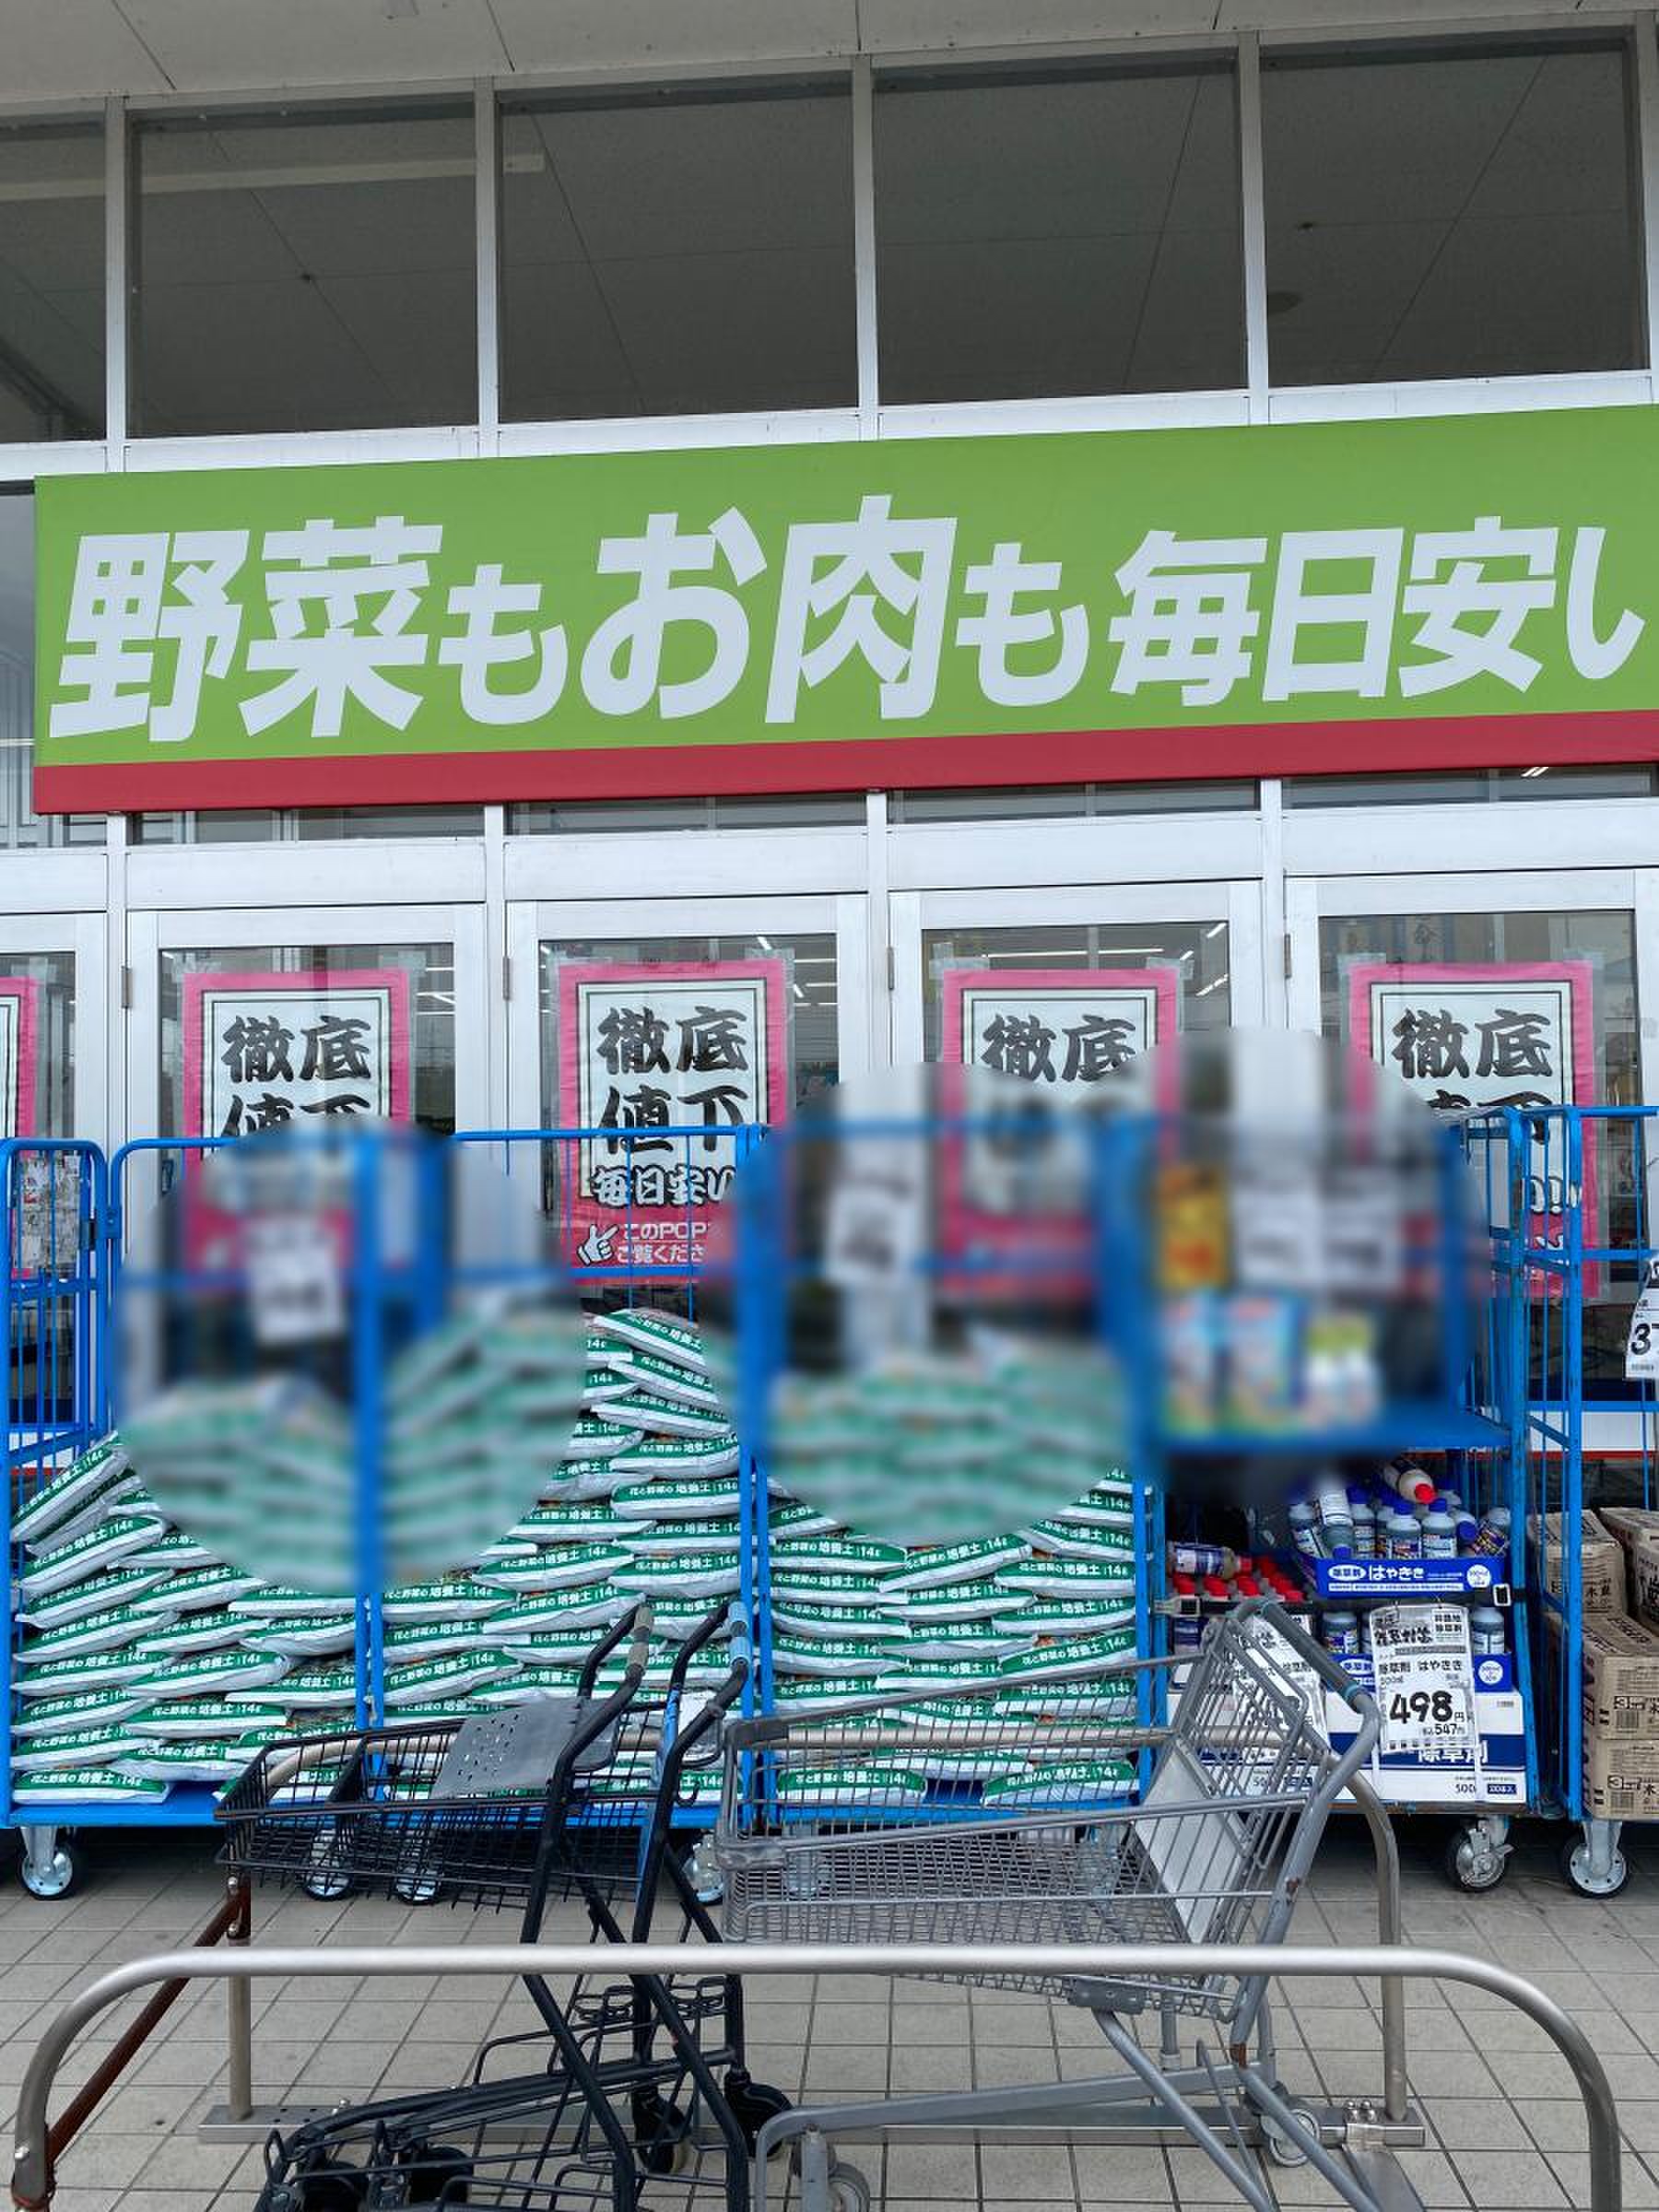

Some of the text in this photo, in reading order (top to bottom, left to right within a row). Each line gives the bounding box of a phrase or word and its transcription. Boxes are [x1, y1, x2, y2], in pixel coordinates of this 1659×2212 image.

[221, 1015, 371, 1082] 徹底
[597, 1006, 747, 1075] 徹底
[981, 1014, 1135, 1082] 徹底
[1392, 1008, 1552, 1078] 徹底
[599, 1085, 748, 1154] 値下
